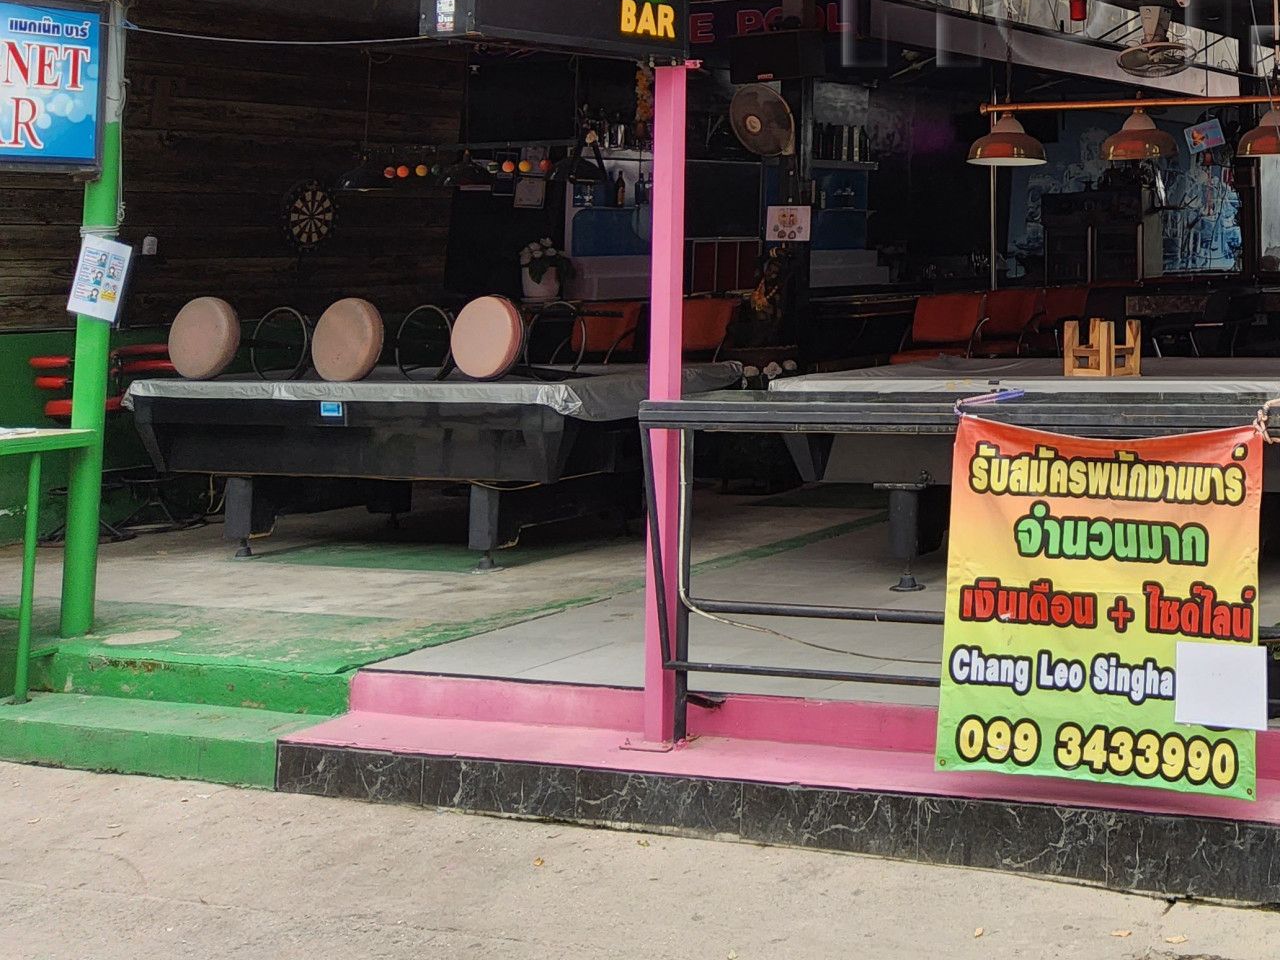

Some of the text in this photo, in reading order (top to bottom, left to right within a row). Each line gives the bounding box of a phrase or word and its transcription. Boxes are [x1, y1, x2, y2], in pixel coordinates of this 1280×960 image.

[64, 22, 91, 39] บาร์
[0, 41, 91, 91] NET
[0, 96, 43, 151] R
[969, 442, 1248, 505] รับสมัครพนักงานบาร์
[1016, 502, 1209, 564] จำนวนมาก
[960, 577, 1097, 628] เงินเดือน
[950, 645, 1174, 703] Chang Leo Singha
[956, 714, 1242, 789] 099 3433990
